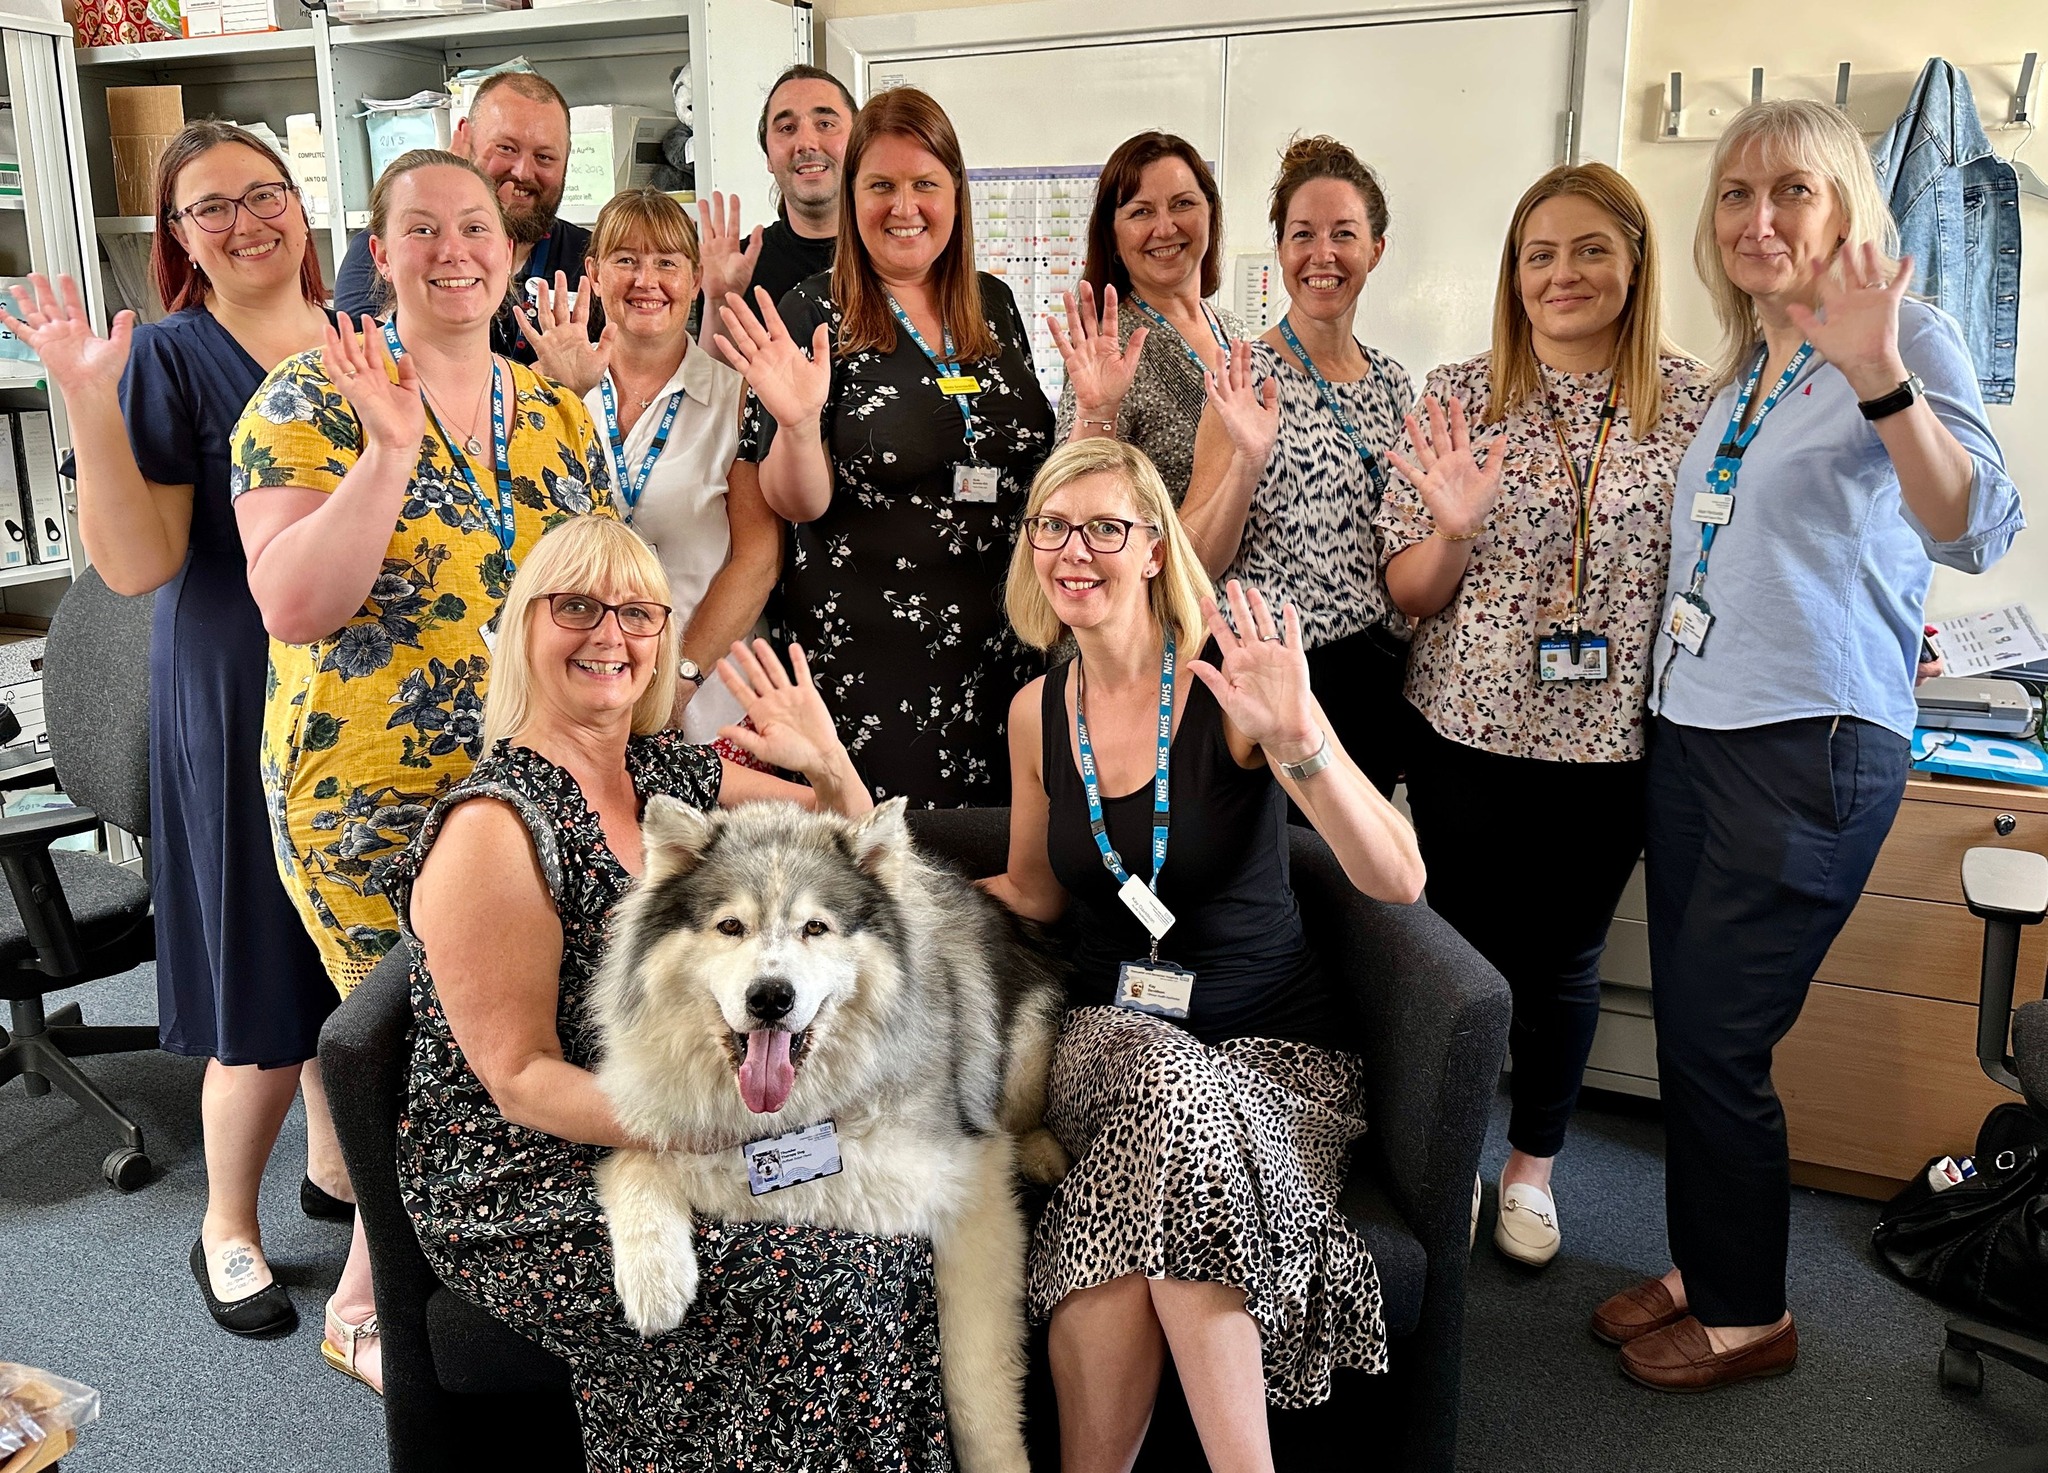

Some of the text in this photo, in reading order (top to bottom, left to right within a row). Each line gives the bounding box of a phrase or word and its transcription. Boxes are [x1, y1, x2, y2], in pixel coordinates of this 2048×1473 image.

[1143, 306, 1160, 318] NHS
[900, 317, 916, 334] NHS
[1160, 321, 1176, 334] NHS
[385, 328, 398, 344] NHS
[916, 336, 930, 351] NHS
[1292, 344, 1308, 360] NHS
[1193, 358, 1208, 372] NHS
[1787, 352, 1806, 374] NHS
[1308, 364, 1322, 382] NHS
[494, 373, 502, 394] NHS
[1742, 378, 1756, 396] NHS
[1770, 378, 1788, 400] NHS
[603, 395, 612, 410] NHS
[670, 395, 680, 410] NHS
[1322, 387, 1336, 404] NHS
[494, 397, 502, 418] NHS
[1732, 403, 1746, 422] NHS
[1752, 405, 1769, 426] NHS
[607, 413, 616, 428] NHS
[662, 414, 674, 430] NHS
[1335, 410, 1349, 427] NHS
[495, 421, 504, 439] NHS
[1349, 432, 1363, 449] NHS
[497, 444, 506, 462] NHS
[644, 456, 656, 470] NHS
[618, 473, 628, 488] NHS
[635, 474, 646, 490] NHS
[470, 482, 486, 500] NHS
[502, 492, 512, 508] NHS
[485, 507, 500, 526] NHS
[504, 513, 514, 530] NHS
[1164, 652, 1174, 674] NHS
[1162, 683, 1172, 706] NHS
[1080, 723, 1089, 746] NHS
[1160, 714, 1170, 738] NHS
[1083, 753, 1094, 776] NHS
[1158, 746, 1168, 770] NHS
[1087, 784, 1099, 806] NHS
[1158, 778, 1167, 802] NHS
[1156, 838, 1166, 858] NH
[222, 1246, 252, 1260] Chloe
